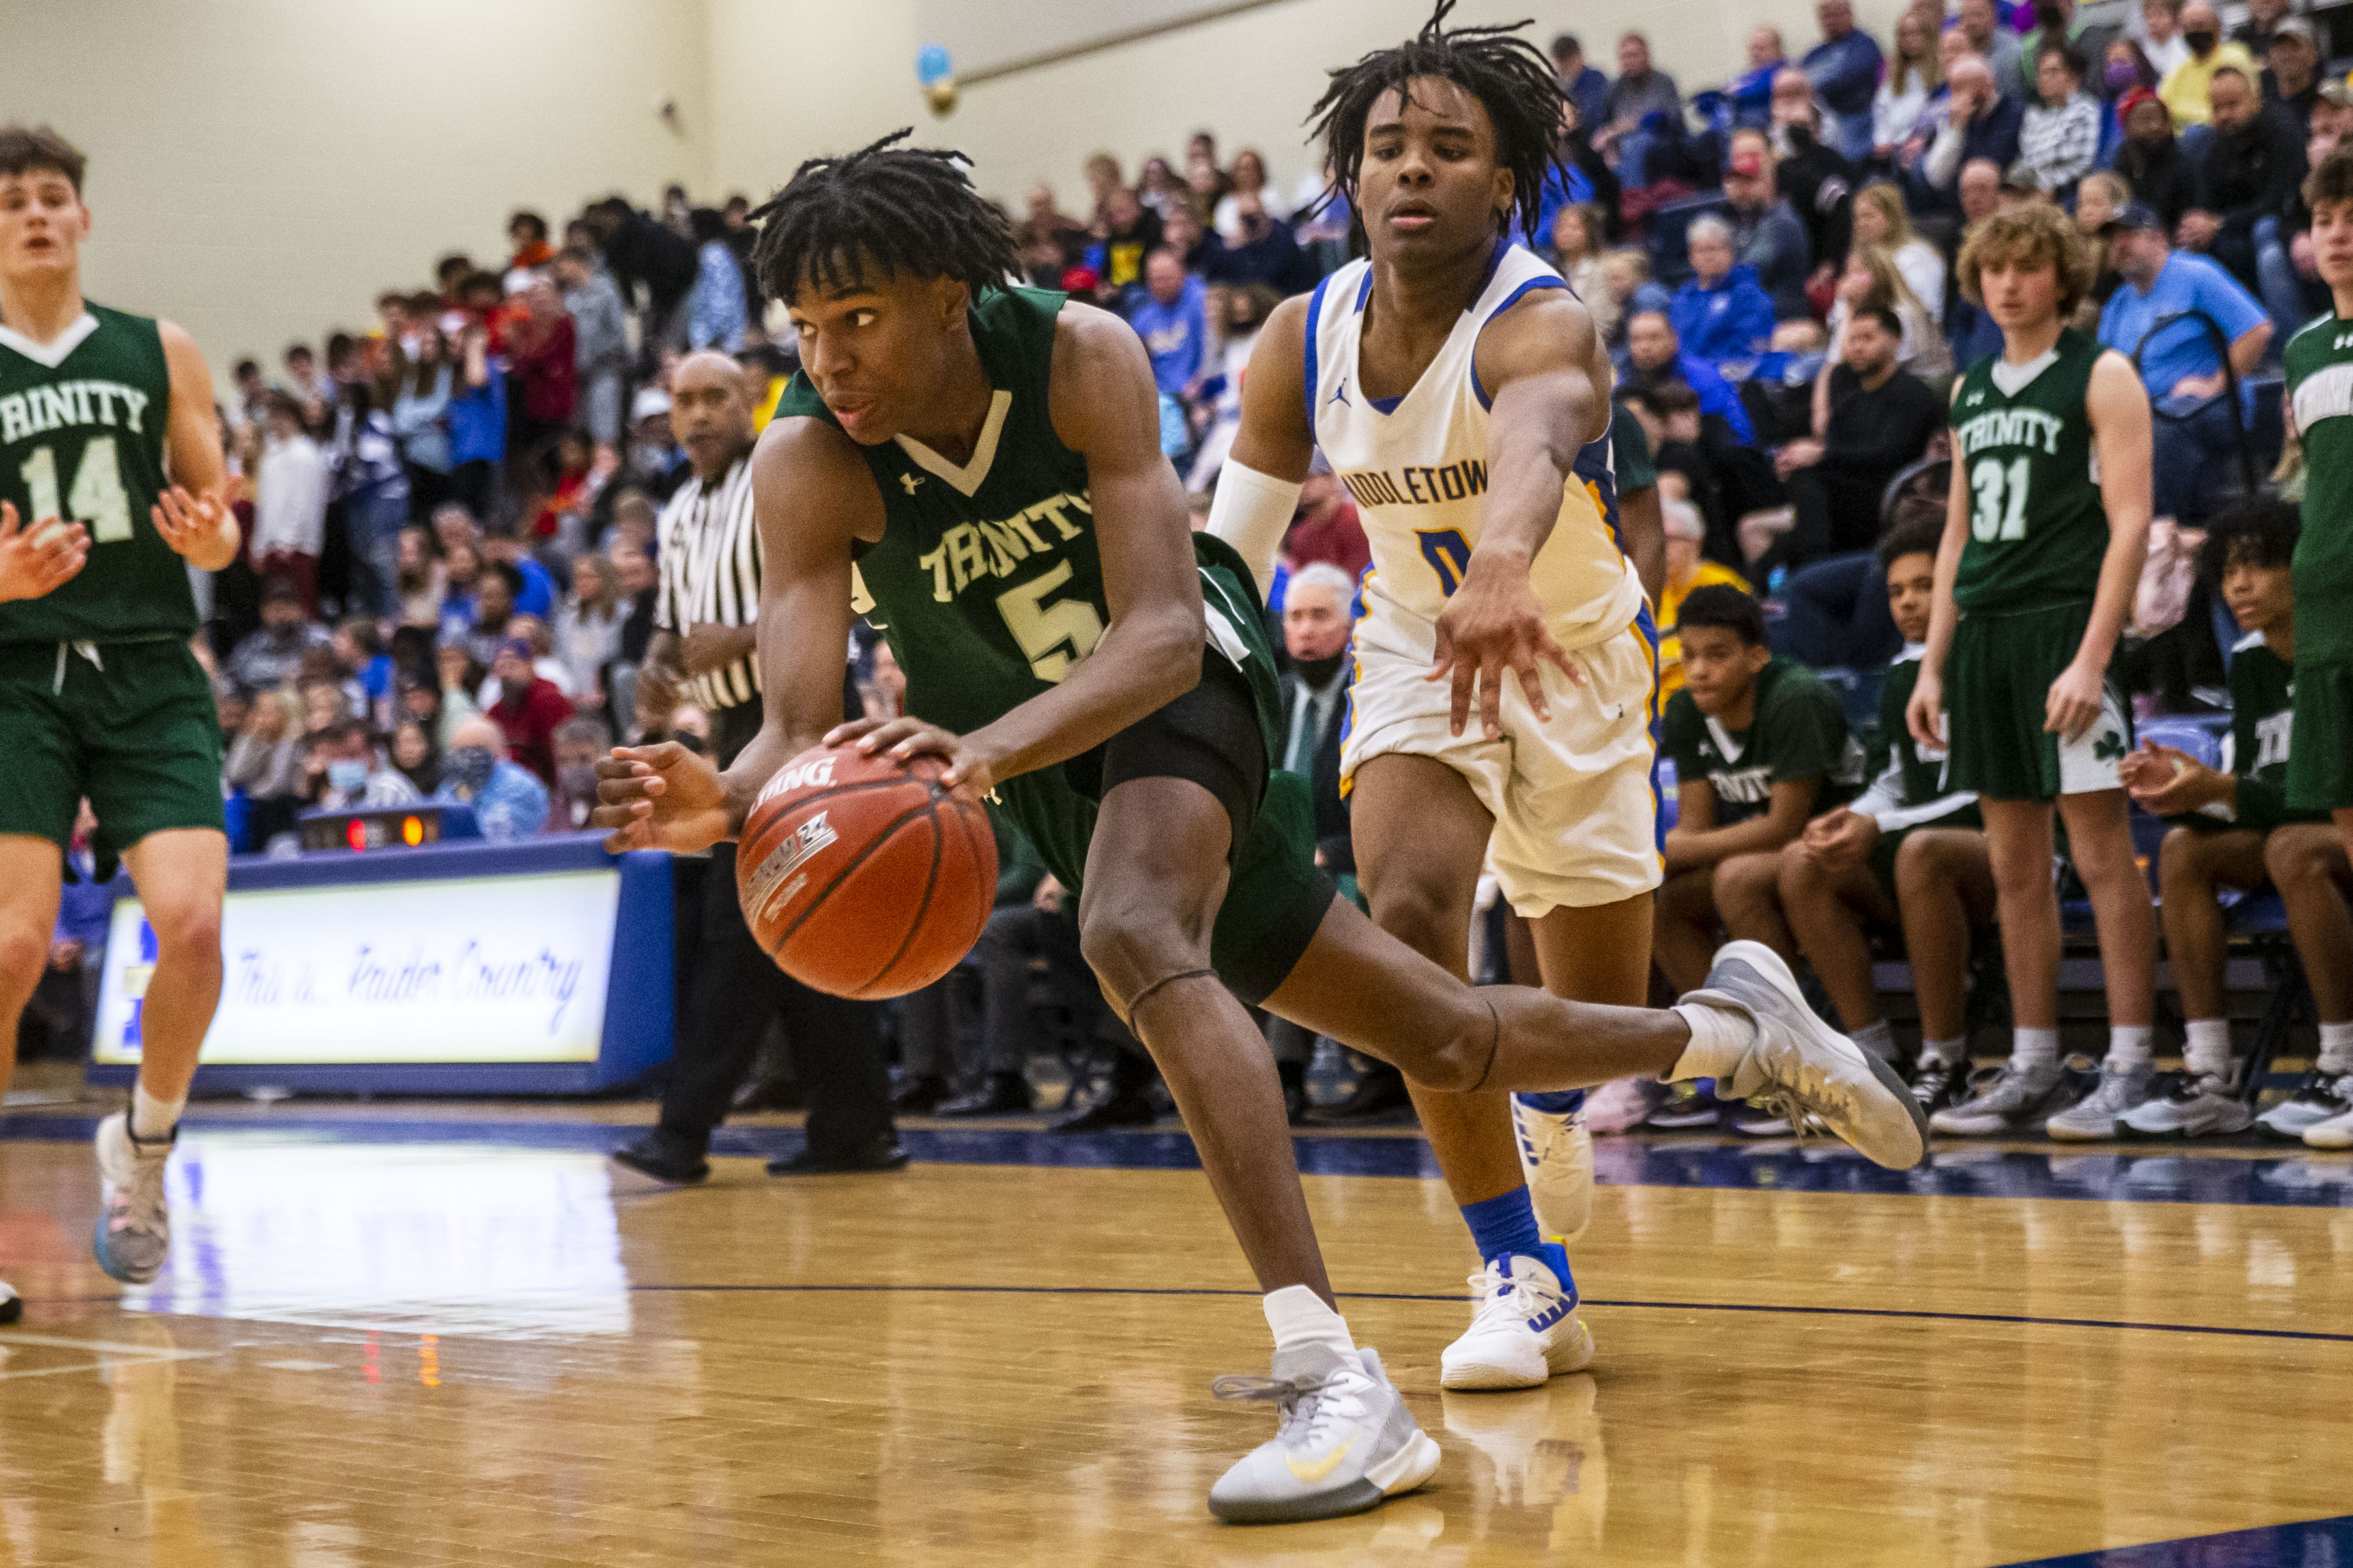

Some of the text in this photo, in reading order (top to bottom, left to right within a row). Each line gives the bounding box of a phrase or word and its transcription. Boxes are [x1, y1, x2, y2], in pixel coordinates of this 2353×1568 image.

[0, 378, 149, 445] RINITY
[1958, 406, 2064, 459] TRINITY
[19, 435, 134, 543] 14
[1340, 459, 1488, 508] IDDLETOW
[1971, 455, 2031, 542] 31
[996, 558, 1104, 684] 5
